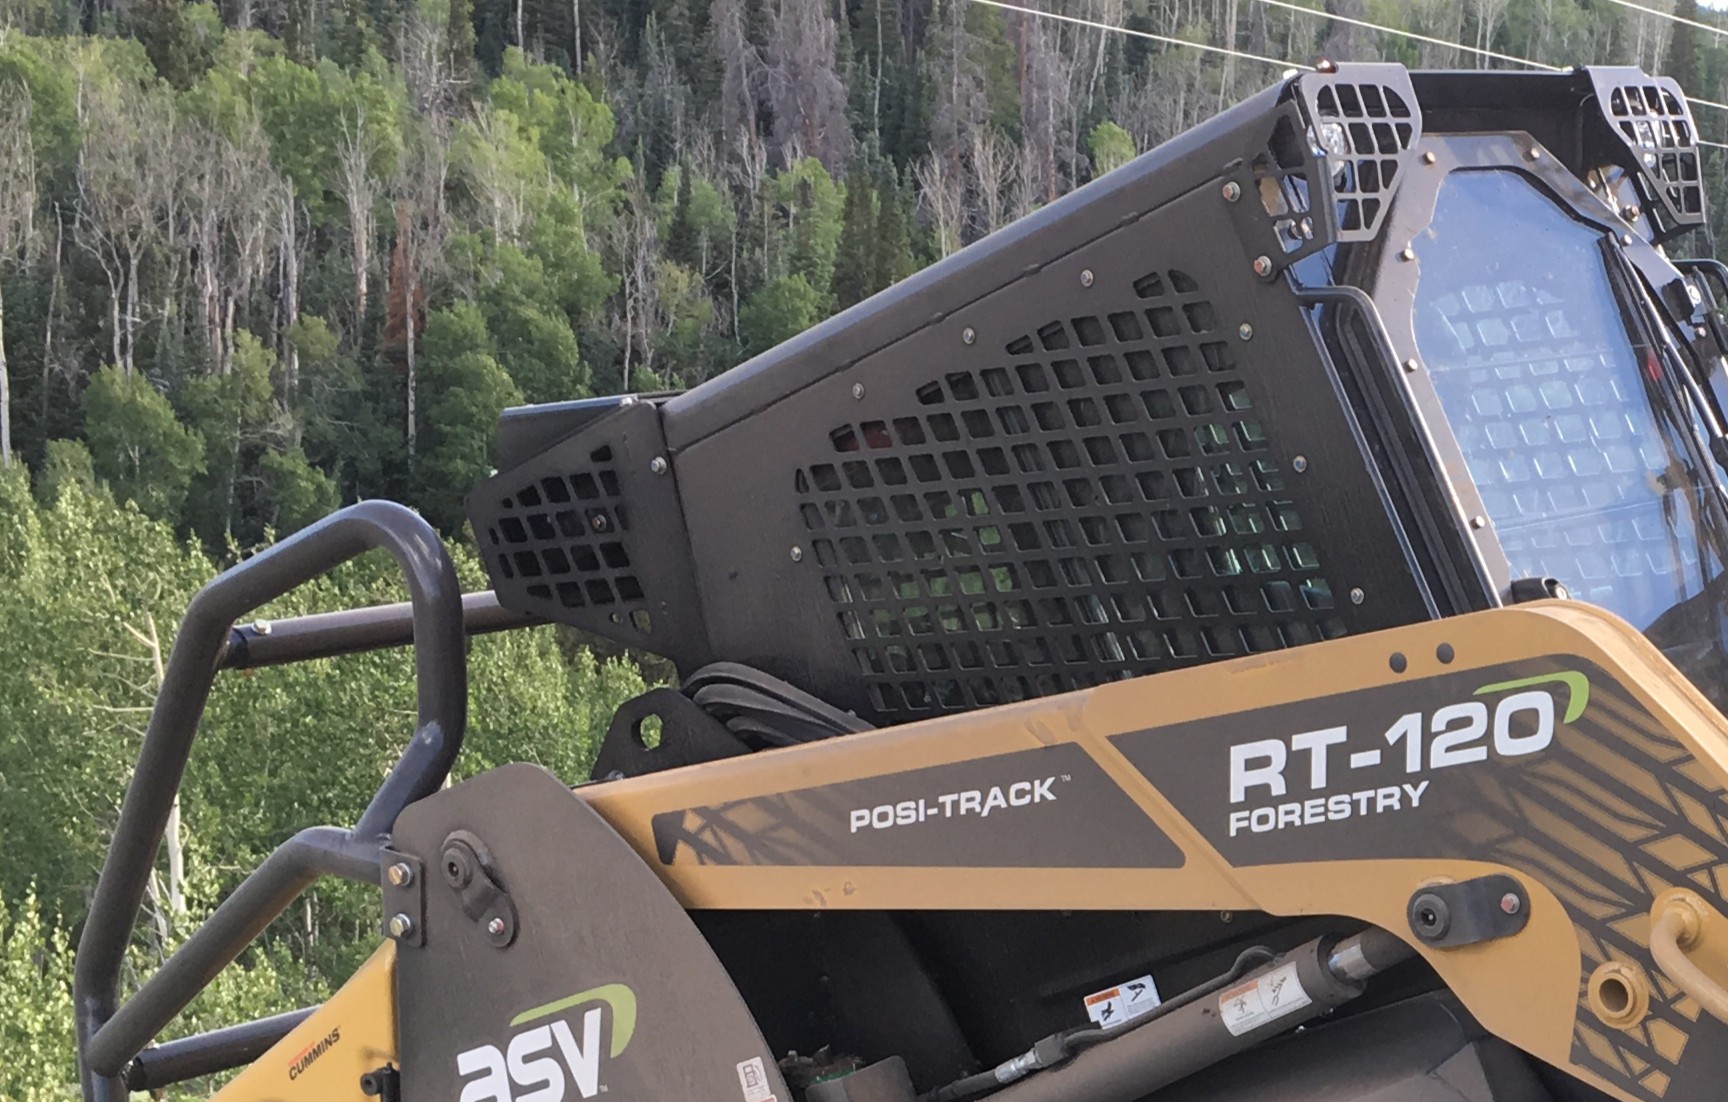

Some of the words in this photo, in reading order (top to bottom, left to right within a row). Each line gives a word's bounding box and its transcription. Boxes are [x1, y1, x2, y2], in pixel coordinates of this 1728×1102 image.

[1230, 691, 1555, 804] RT-120
[850, 776, 1057, 833] POSI-TRACK
[1229, 781, 1430, 837] FORESTRY
[288, 1027, 340, 1081] CUMMINS
